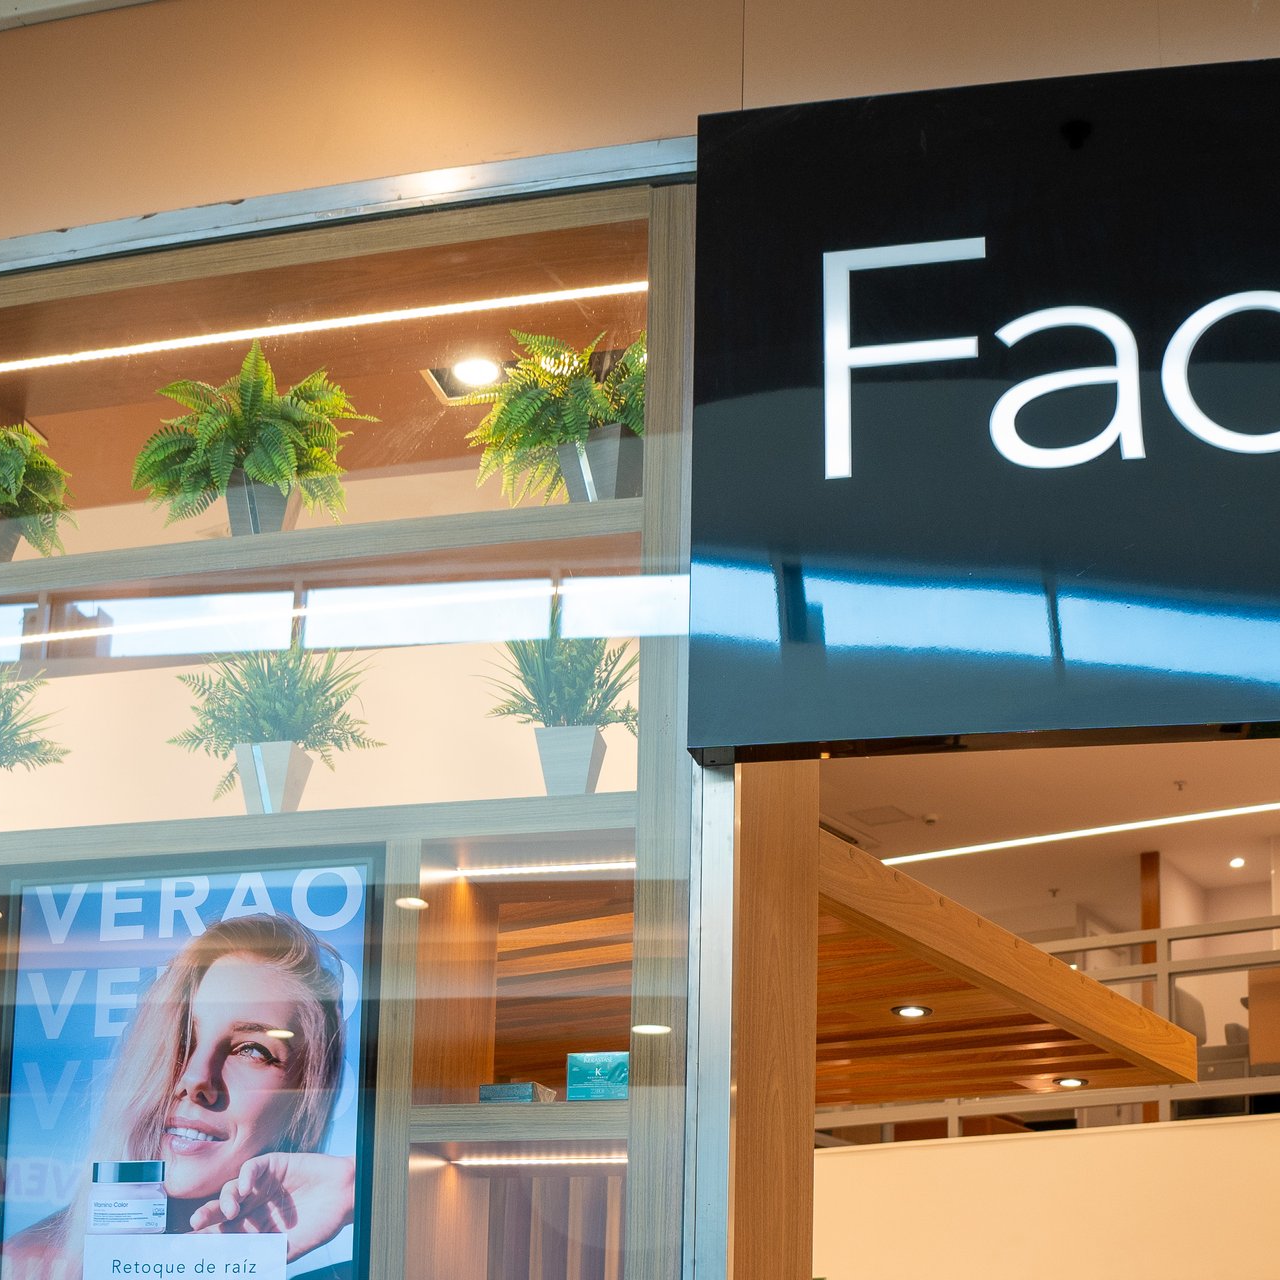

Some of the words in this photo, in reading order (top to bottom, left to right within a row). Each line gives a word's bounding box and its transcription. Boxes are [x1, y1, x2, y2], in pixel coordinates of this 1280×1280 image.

[112, 1259, 186, 1276] Retoque
[194, 1259, 216, 1275] de
[224, 1258, 257, 1274] raíz
